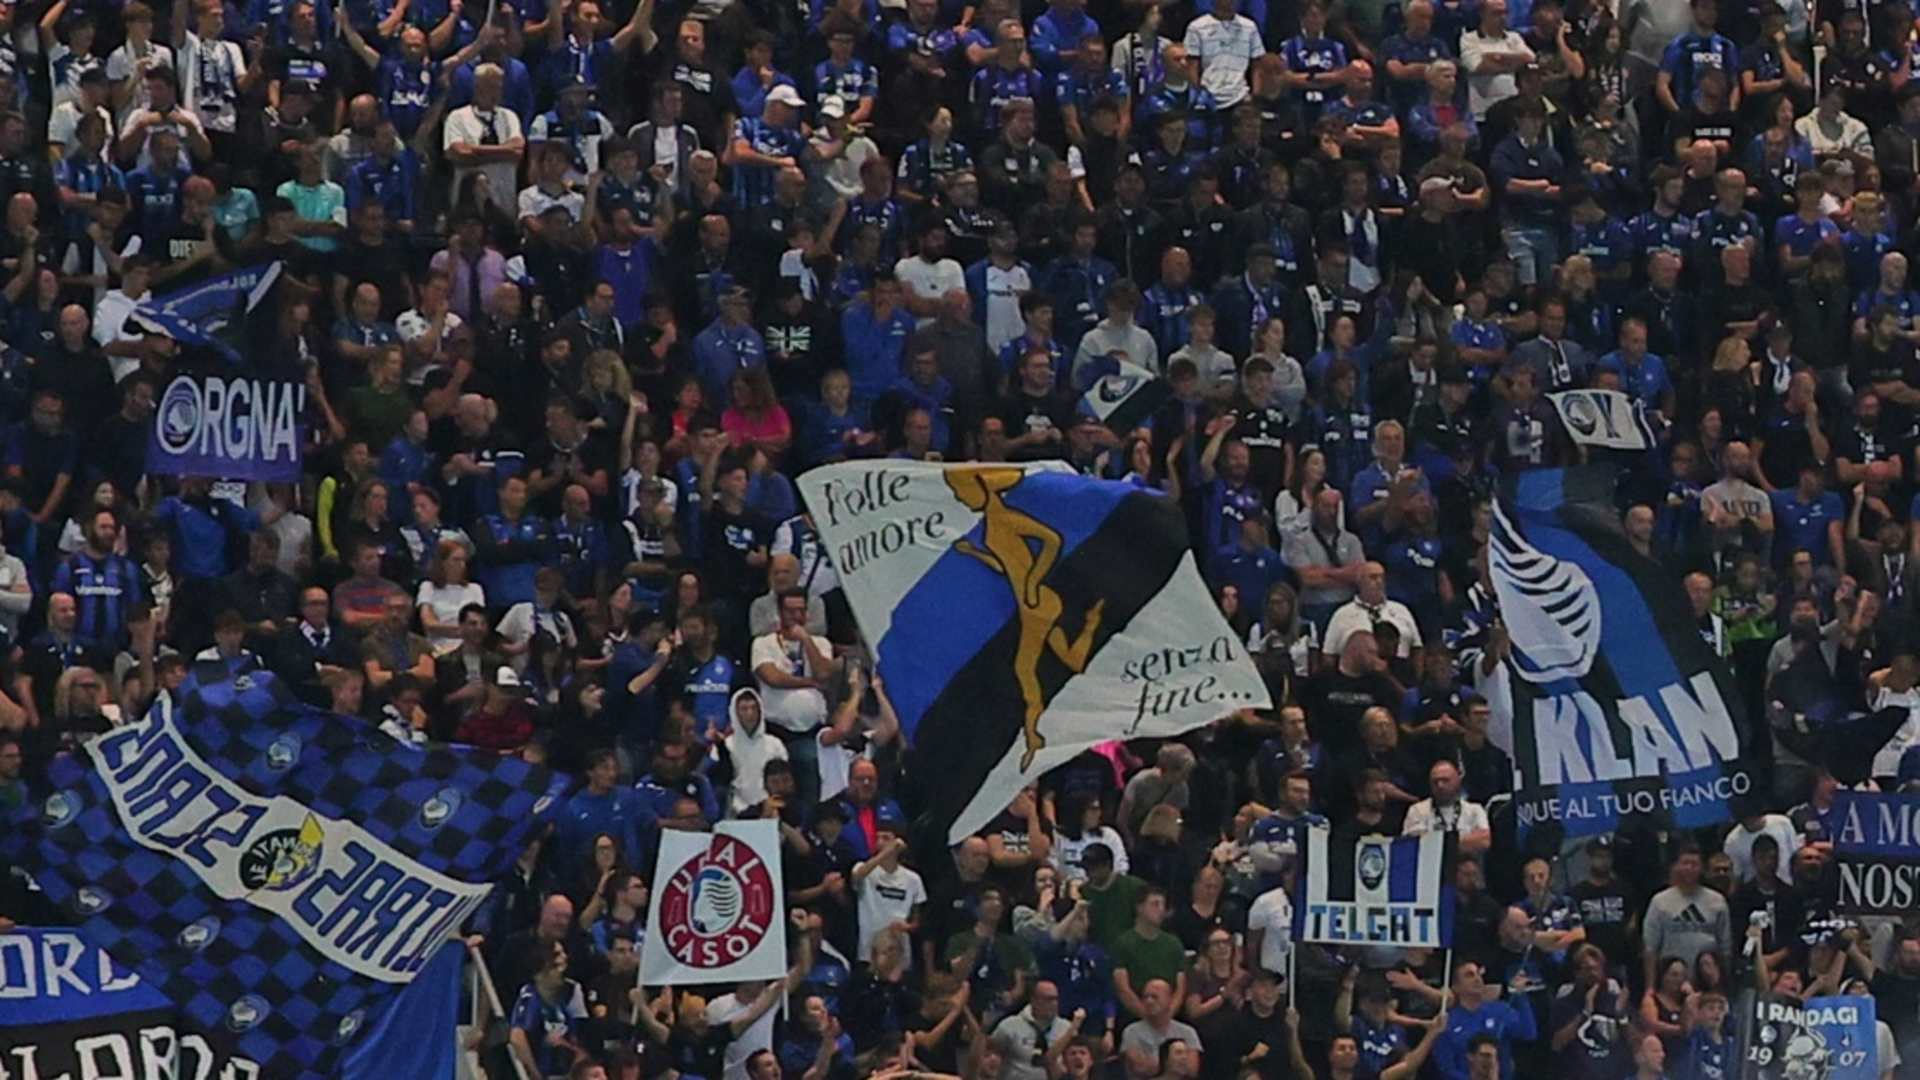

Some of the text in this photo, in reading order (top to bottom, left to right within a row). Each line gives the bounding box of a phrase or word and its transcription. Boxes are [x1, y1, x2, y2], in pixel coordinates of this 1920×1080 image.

[824, 469, 910, 527] Folle
[839, 511, 945, 575] amore
[1120, 636, 1236, 683] senza
[1533, 671, 1739, 785] KLAN
[1565, 796, 1597, 819] AL
[1597, 790, 1655, 817] TUO
[1659, 771, 1751, 810] FIANCO
[1840, 800, 1920, 846] A M
[1836, 863, 1920, 909] NOS
[1310, 905, 1434, 943] TELGAT
[1756, 1001, 1858, 1027] I RANDAGI
[1749, 1045, 1773, 1066] 19
[1839, 1051, 1867, 1067] 07
